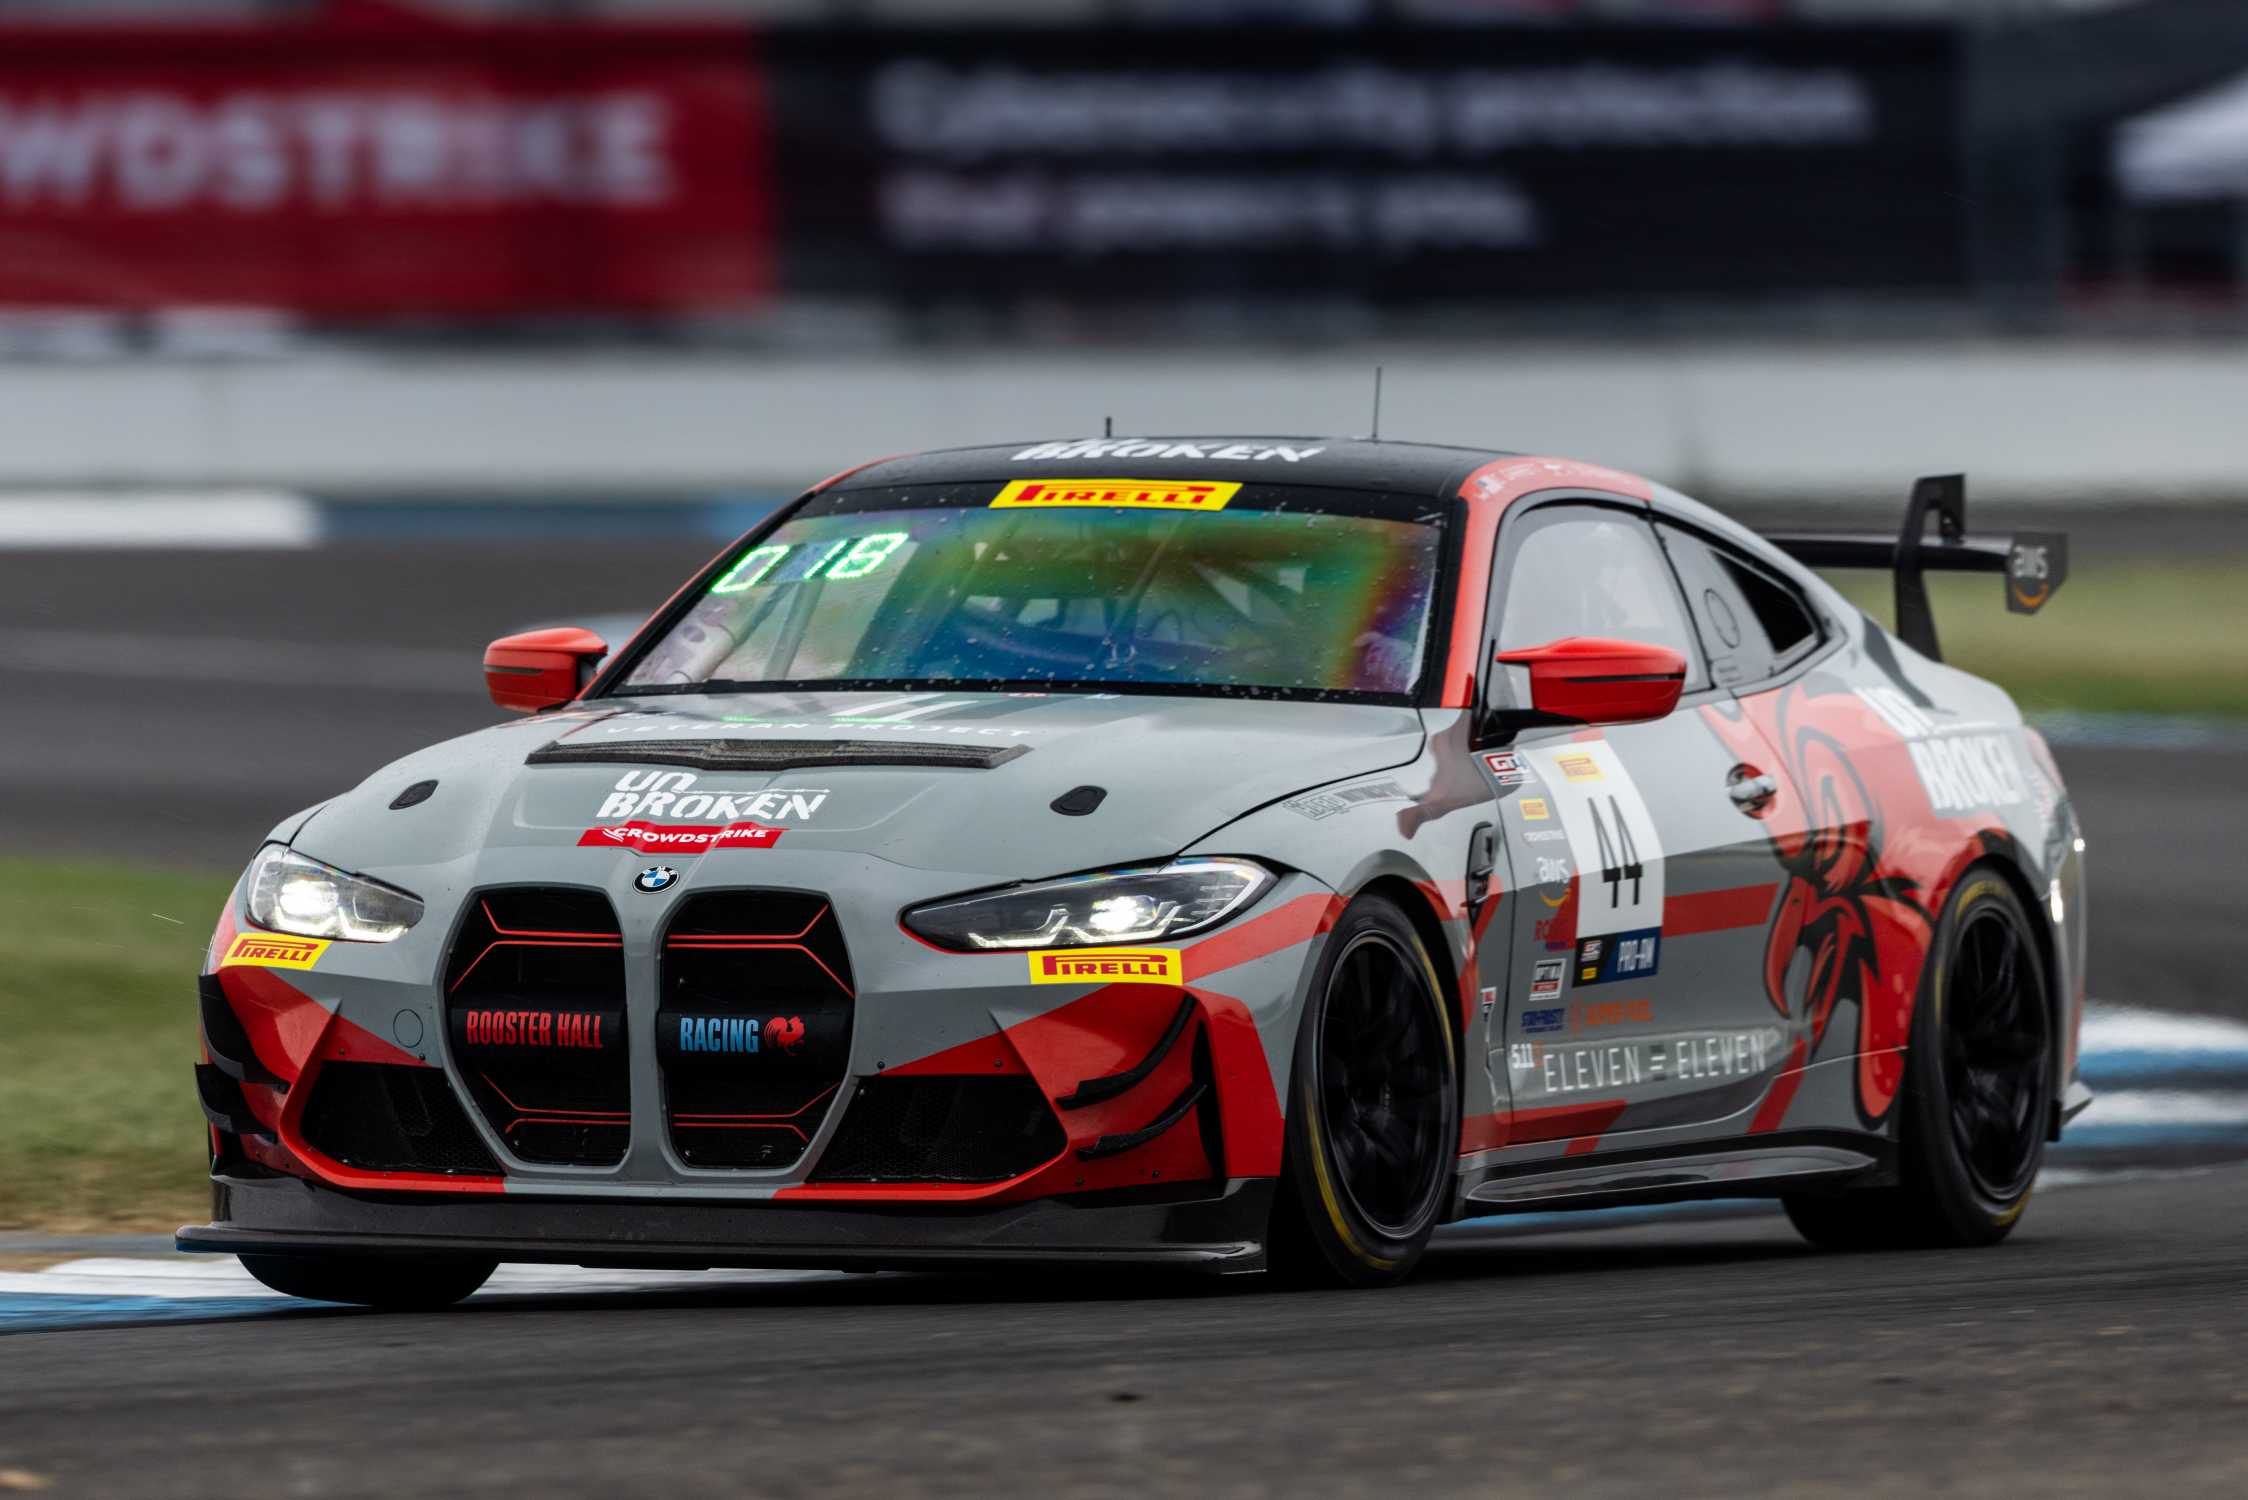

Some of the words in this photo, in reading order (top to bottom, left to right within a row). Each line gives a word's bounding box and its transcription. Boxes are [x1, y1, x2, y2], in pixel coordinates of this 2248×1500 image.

[1010, 438, 1325, 464] BROKEN
[1013, 483, 1216, 505] PIRELLI
[608, 722, 809, 735] VETERAN
[829, 723, 1032, 737] PROJECT
[614, 770, 697, 793] UN
[596, 792, 827, 820] BROKEN
[614, 827, 769, 844] CROWDSTRIKE
[1587, 795, 1644, 909] 44
[232, 938, 319, 962] PIRELLI
[1616, 936, 1656, 975] PRO-AM
[1043, 954, 1167, 976] PIRELLI
[467, 1010, 552, 1047] ROOSTER
[557, 1013, 603, 1049] HALL
[679, 1016, 759, 1053] RACING
[1543, 1046, 1640, 1092] ELEVEN
[1675, 1036, 1766, 1080] ELEVEN
